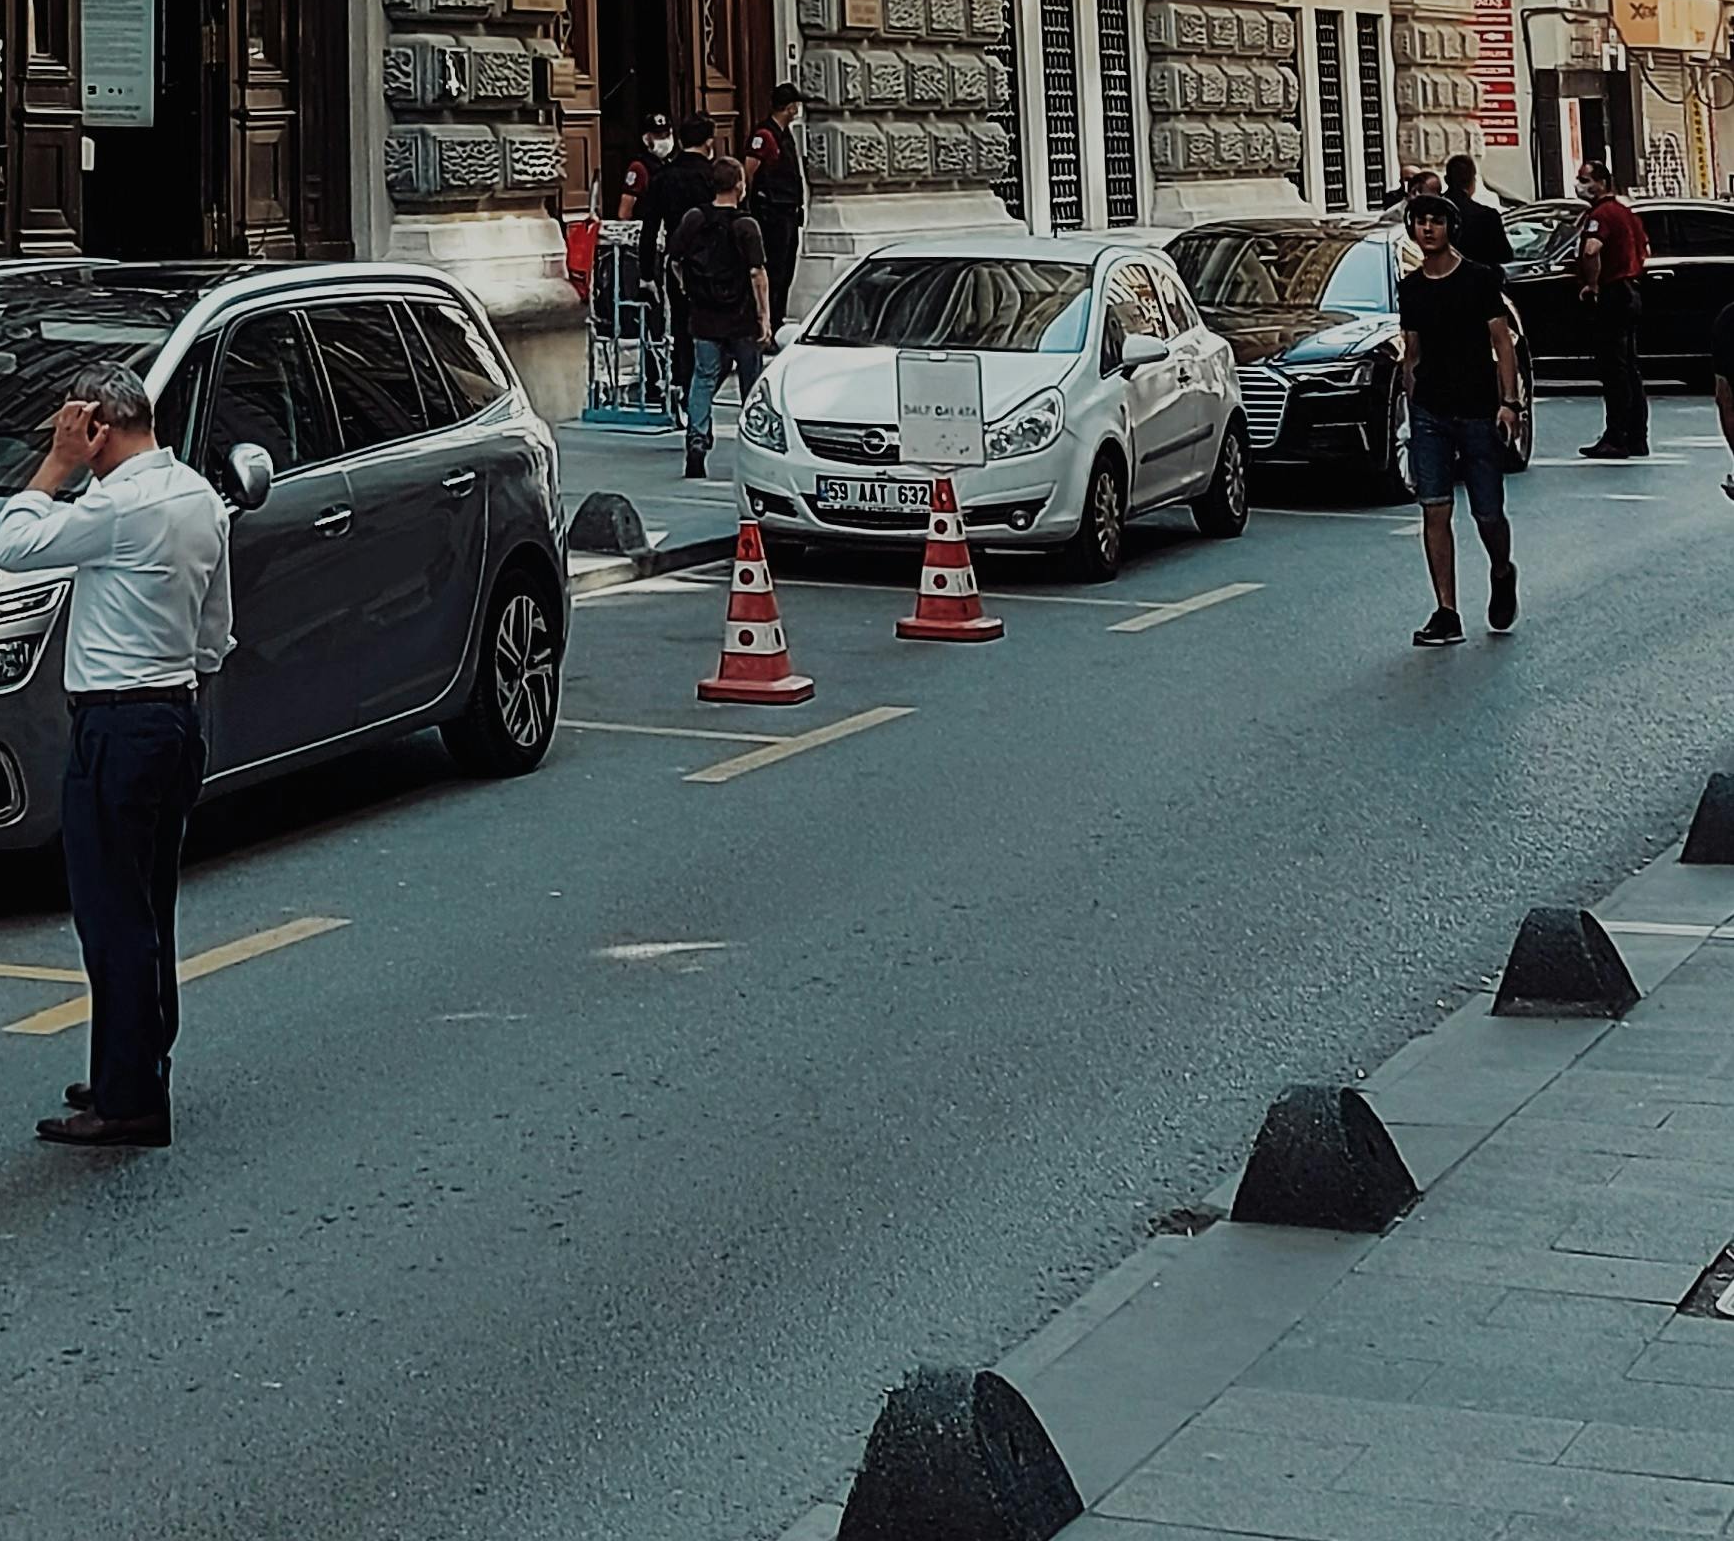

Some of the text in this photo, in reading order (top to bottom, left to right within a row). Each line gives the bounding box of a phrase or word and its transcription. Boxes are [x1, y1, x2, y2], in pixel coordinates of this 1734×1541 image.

[828, 481, 929, 505] 59 AAT 632
